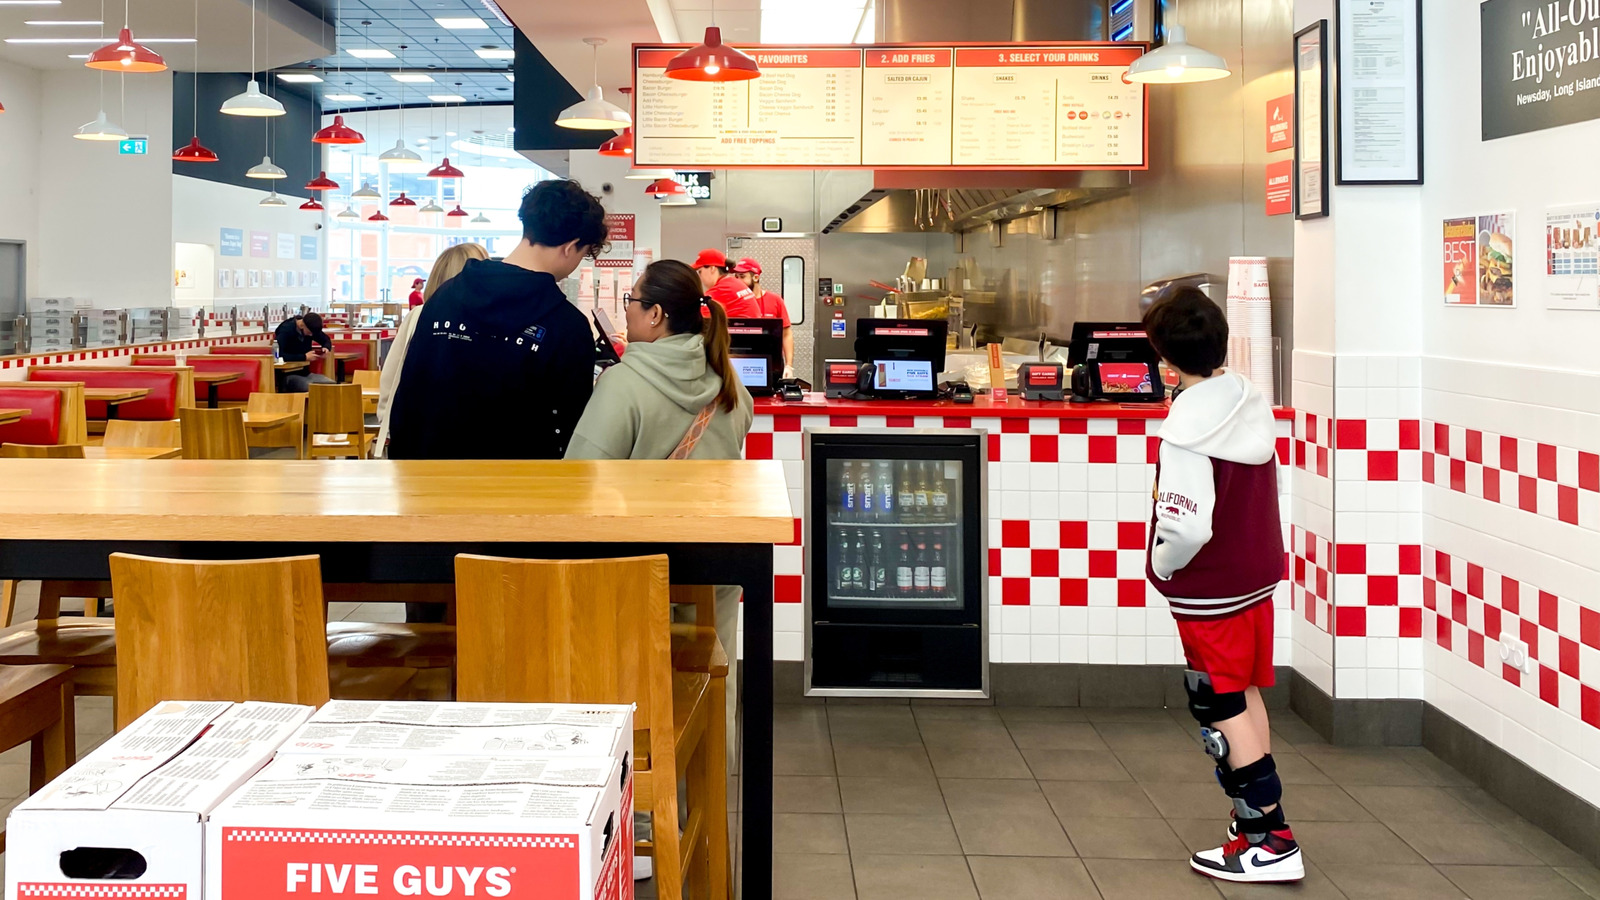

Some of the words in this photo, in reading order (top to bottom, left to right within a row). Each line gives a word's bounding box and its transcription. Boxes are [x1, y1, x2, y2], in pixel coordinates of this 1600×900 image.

[758, 54, 808, 64] FAVOURITES
[881, 54, 890, 63] 2.
[892, 54, 909, 63] ADD
[911, 54, 935, 63] FRIES
[998, 53, 1007, 62] 3.
[1010, 53, 1041, 62] SELECT
[1043, 53, 1065, 62] YOUR
[1068, 53, 1099, 62] DRINKS
[1512, 27, 1600, 84] Enjoyabl
[1516, 88, 1552, 106] Newsday,
[1554, 82, 1574, 96] Long
[1444, 240, 1475, 263] BEST
[847, 483, 855, 508] smart
[864, 483, 873, 508] smart
[884, 483, 892, 509] smart
[287, 862, 378, 894] FIVE
[393, 865, 512, 897] GUYS
